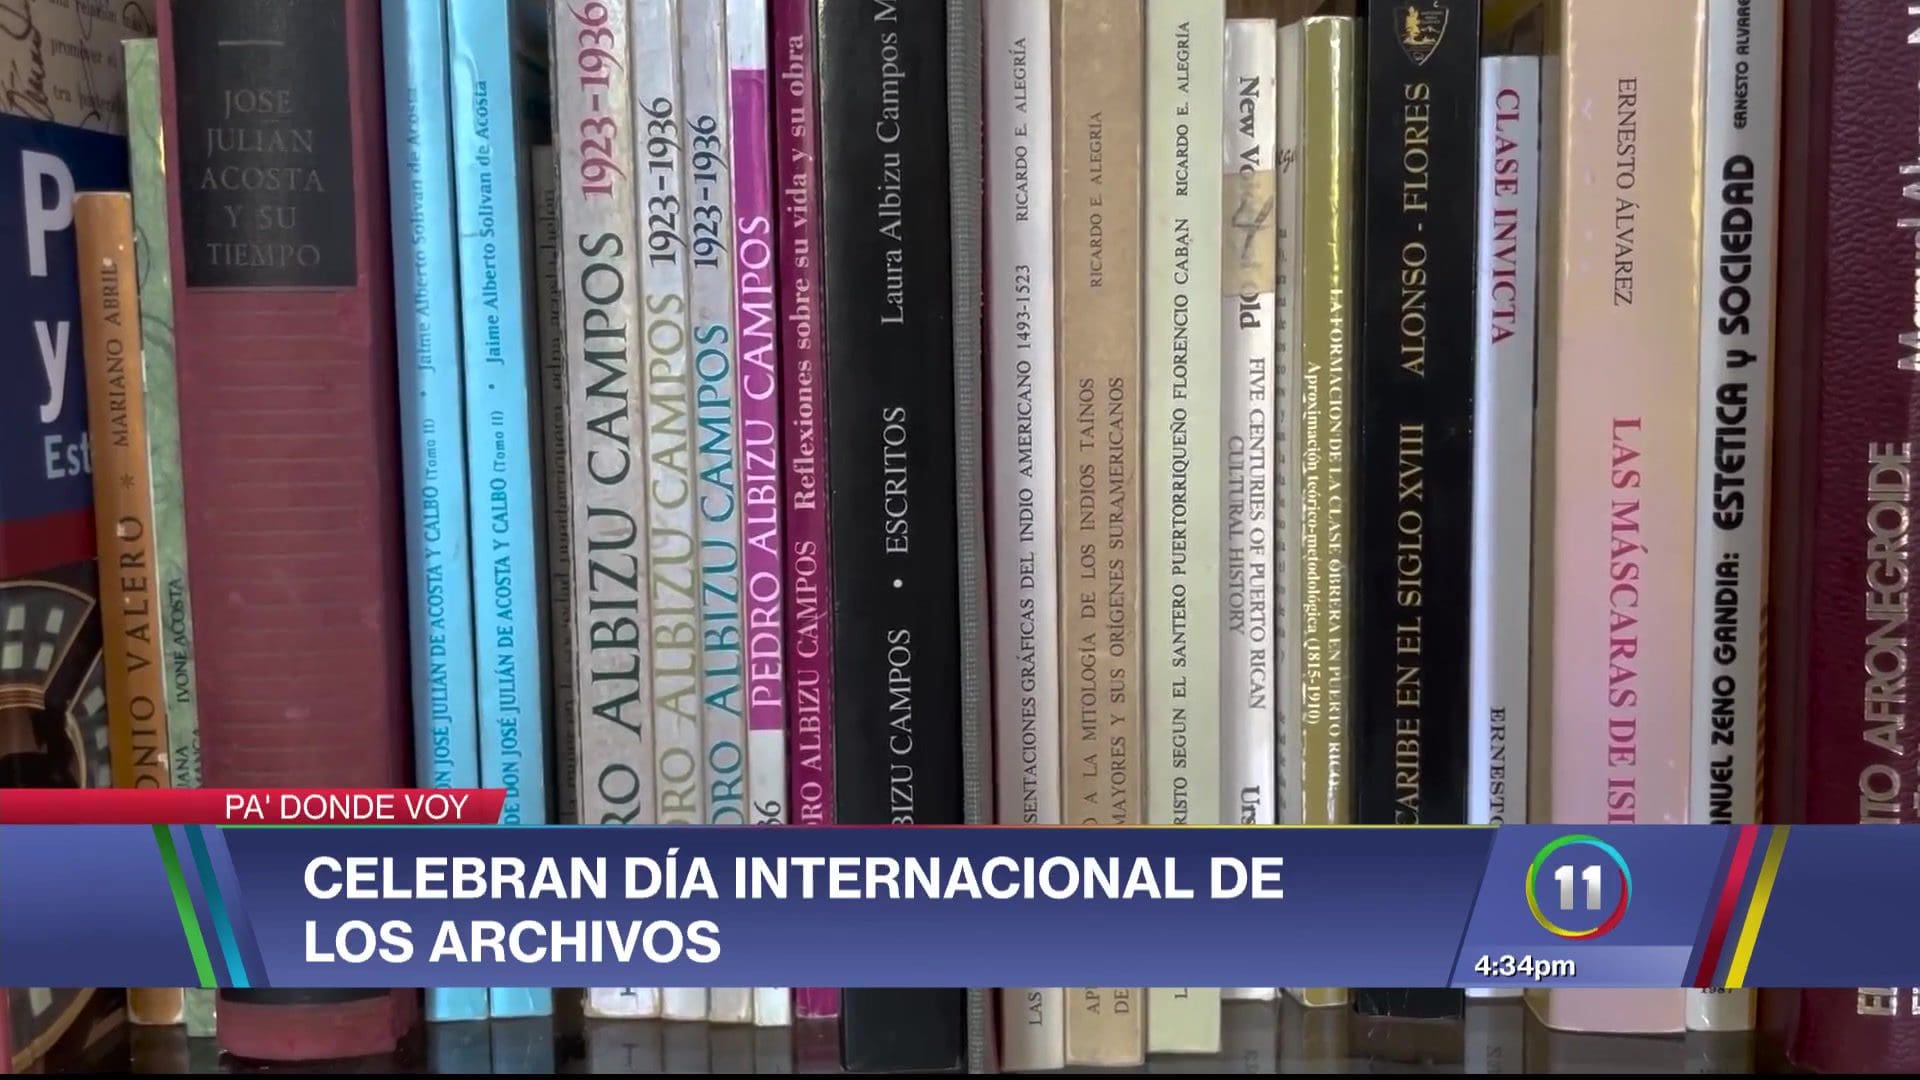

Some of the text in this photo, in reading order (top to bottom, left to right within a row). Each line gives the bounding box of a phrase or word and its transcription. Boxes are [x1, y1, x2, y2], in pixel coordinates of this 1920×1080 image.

[225, 89, 291, 119] JOSE
[567, 1, 626, 200] 1923-1936
[1009, 37, 1029, 222] RICARDO E. ALEGRÍA
[1174, 21, 1191, 197] RICARDO E. ALEGRÍA
[1238, 76, 1260, 138] New
[1733, 60, 1749, 130] ERNESTO
[201, 167, 325, 193] ACOSTA
[639, 96, 686, 268] 1923-1936
[875, 32, 906, 325] Laura Albizu Campos
[1088, 111, 1103, 185] ALEGRÍA
[226, 205, 297, 230] Y SU
[409, 180, 426, 244] Solivan
[473, 80, 505, 366] Jaime Alberto Solivan de Acosta
[687, 114, 727, 269] 1923-1936
[1400, 81, 1430, 377] ALONSO FLORES
[1491, 88, 1520, 345] CLASE INVICTA
[1613, 77, 1639, 306] ERNESTO ÁLVAREZ
[207, 243, 321, 267] TIEMPO
[784, 35, 817, 511] Reflexiones sobre su vida y su obra
[1090, 213, 1103, 288] RICARDO
[1718, 154, 1755, 335] SOCIEDAD
[412, 250, 431, 316] Alberto
[34, 321, 70, 423] y
[101, 263, 129, 447] MARIANO ABRIL
[415, 322, 435, 372] Jaime
[578, 232, 630, 485] CAMPOS
[646, 293, 689, 510] CAMPOS
[1076, 377, 1095, 452] TAÍNOS
[492, 431, 507, 472] (Tomo
[739, 215, 782, 707] PEDRO ALBIZU CAMPOS
[882, 407, 909, 554] ESCRITOS
[1015, 264, 1036, 692] GRÁFICAS DEL INDIO AMERICANO 1493-1523
[1328, 438, 1342, 462] DE
[1328, 467, 1342, 491] LA
[1399, 422, 1425, 502] XVIII
[1712, 383, 1748, 531] ESTETICA
[422, 486, 442, 542] CALBO
[490, 478, 508, 534] CALBO
[694, 324, 742, 718] ALBIZU CAMPOS
[1080, 464, 1096, 531] INDIOS
[1168, 219, 1190, 768] SEGUN EL SANTERO PUERTORRIQUEÑO FLORENCIO CABAN
[1328, 495, 1342, 555] CLASE
[424, 547, 442, 559] Y
[493, 539, 510, 550] Y
[1080, 544, 1096, 579] LOS
[1106, 377, 1125, 726] Y SUS ORÍGENES SURAMERICANOS
[1228, 435, 1245, 635] CULTURAL HISTORY
[1248, 357, 1267, 710] FIVE CENTURIES OF PUERTO RICAN
[1302, 361, 1322, 724] Aproximación teórico-metodológica (1815-1910)
[1397, 511, 1423, 607] SIGLO
[117, 517, 151, 672] VALERO
[168, 579, 185, 646] ACOSTA
[423, 565, 445, 629] ACOSTA
[494, 556, 513, 621] ACOSTA
[587, 504, 642, 742] ALBIZU
[651, 527, 697, 723] ALBIZU
[795, 540, 820, 658] CAMPOS
[1080, 593, 1096, 619] DE
[1328, 559, 1342, 633] OBRERA
[1607, 417, 1648, 767] LAS MÁSCARAS DE
[1862, 441, 1911, 756] AFRONEGROIDE
[424, 634, 446, 656] DE
[497, 625, 515, 648] DE
[1328, 638, 1342, 661] EN
[1397, 616, 1422, 656] EL
[1710, 552, 1739, 746] ZENO GANDIA:
[493, 654, 520, 713] JULIÁN
[797, 668, 823, 771] ALBIZU
[888, 629, 914, 754] CAMPOS
[1078, 632, 1097, 741] MITOLOGÍA
[1328, 665, 1342, 737] PUERTO
[1396, 664, 1421, 707] EN
[430, 726, 454, 766] JOSÉ
[496, 717, 521, 757] JOSÉ
[1082, 754, 1098, 777] LA
[500, 762, 520, 798] DON
[1082, 790, 1098, 805] A
[1028, 992, 1042, 1026] LAS
